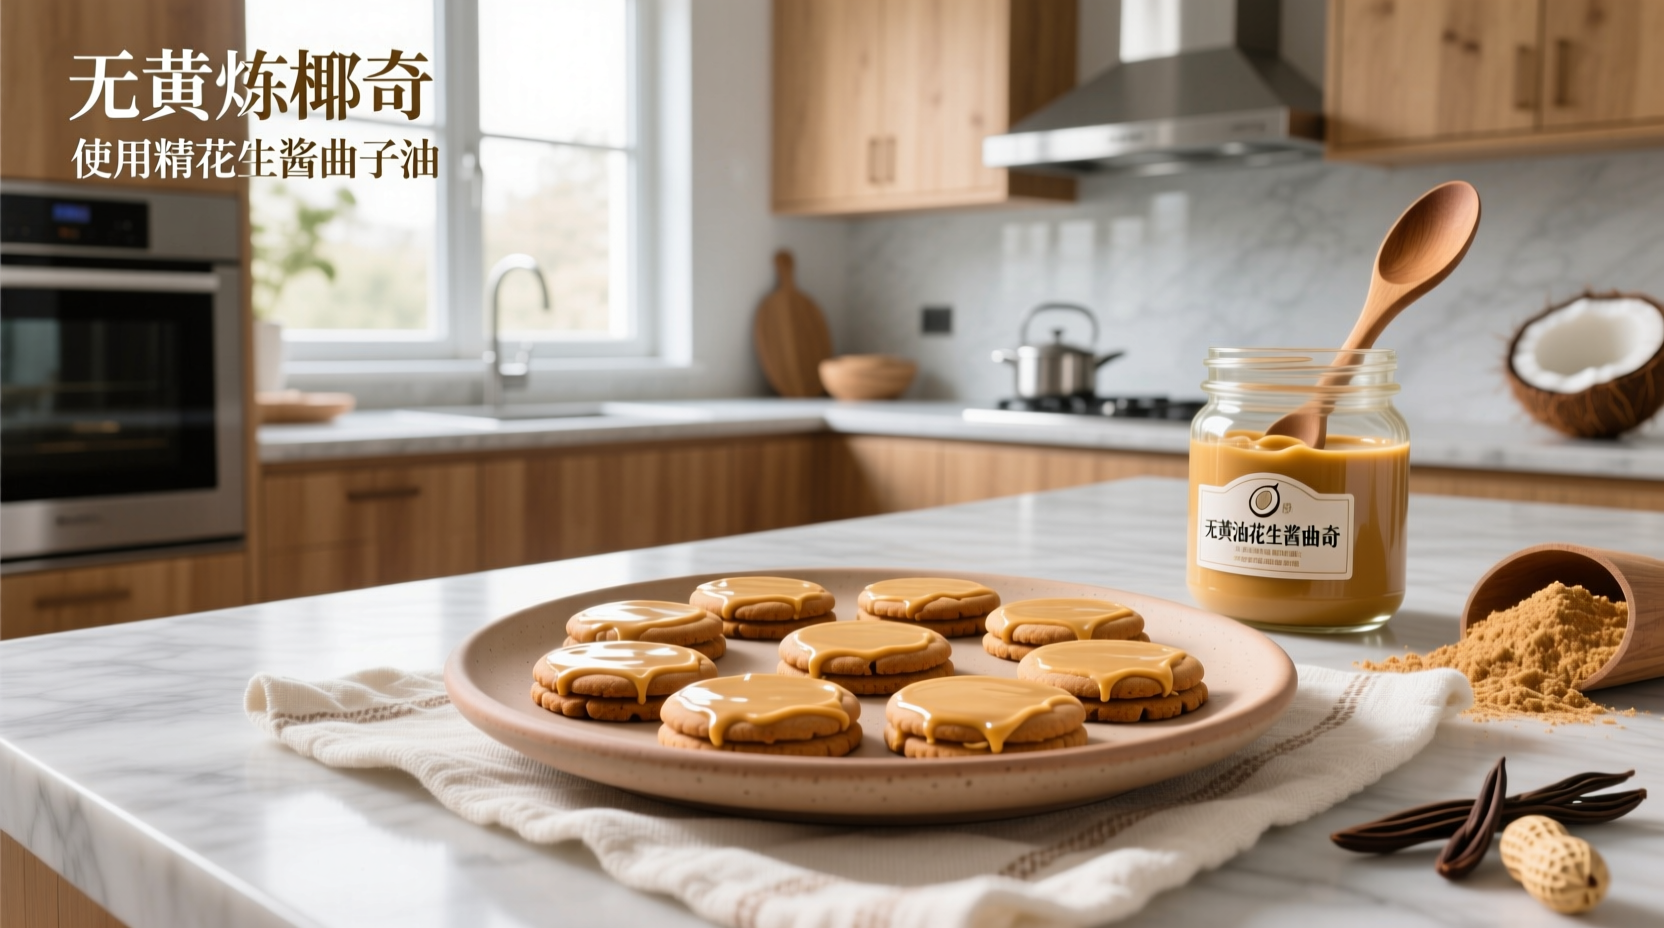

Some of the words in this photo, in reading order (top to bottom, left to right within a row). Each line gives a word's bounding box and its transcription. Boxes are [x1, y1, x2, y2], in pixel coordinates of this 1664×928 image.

[1205, 519, 1340, 548] 无黄油花生酱曲奇
